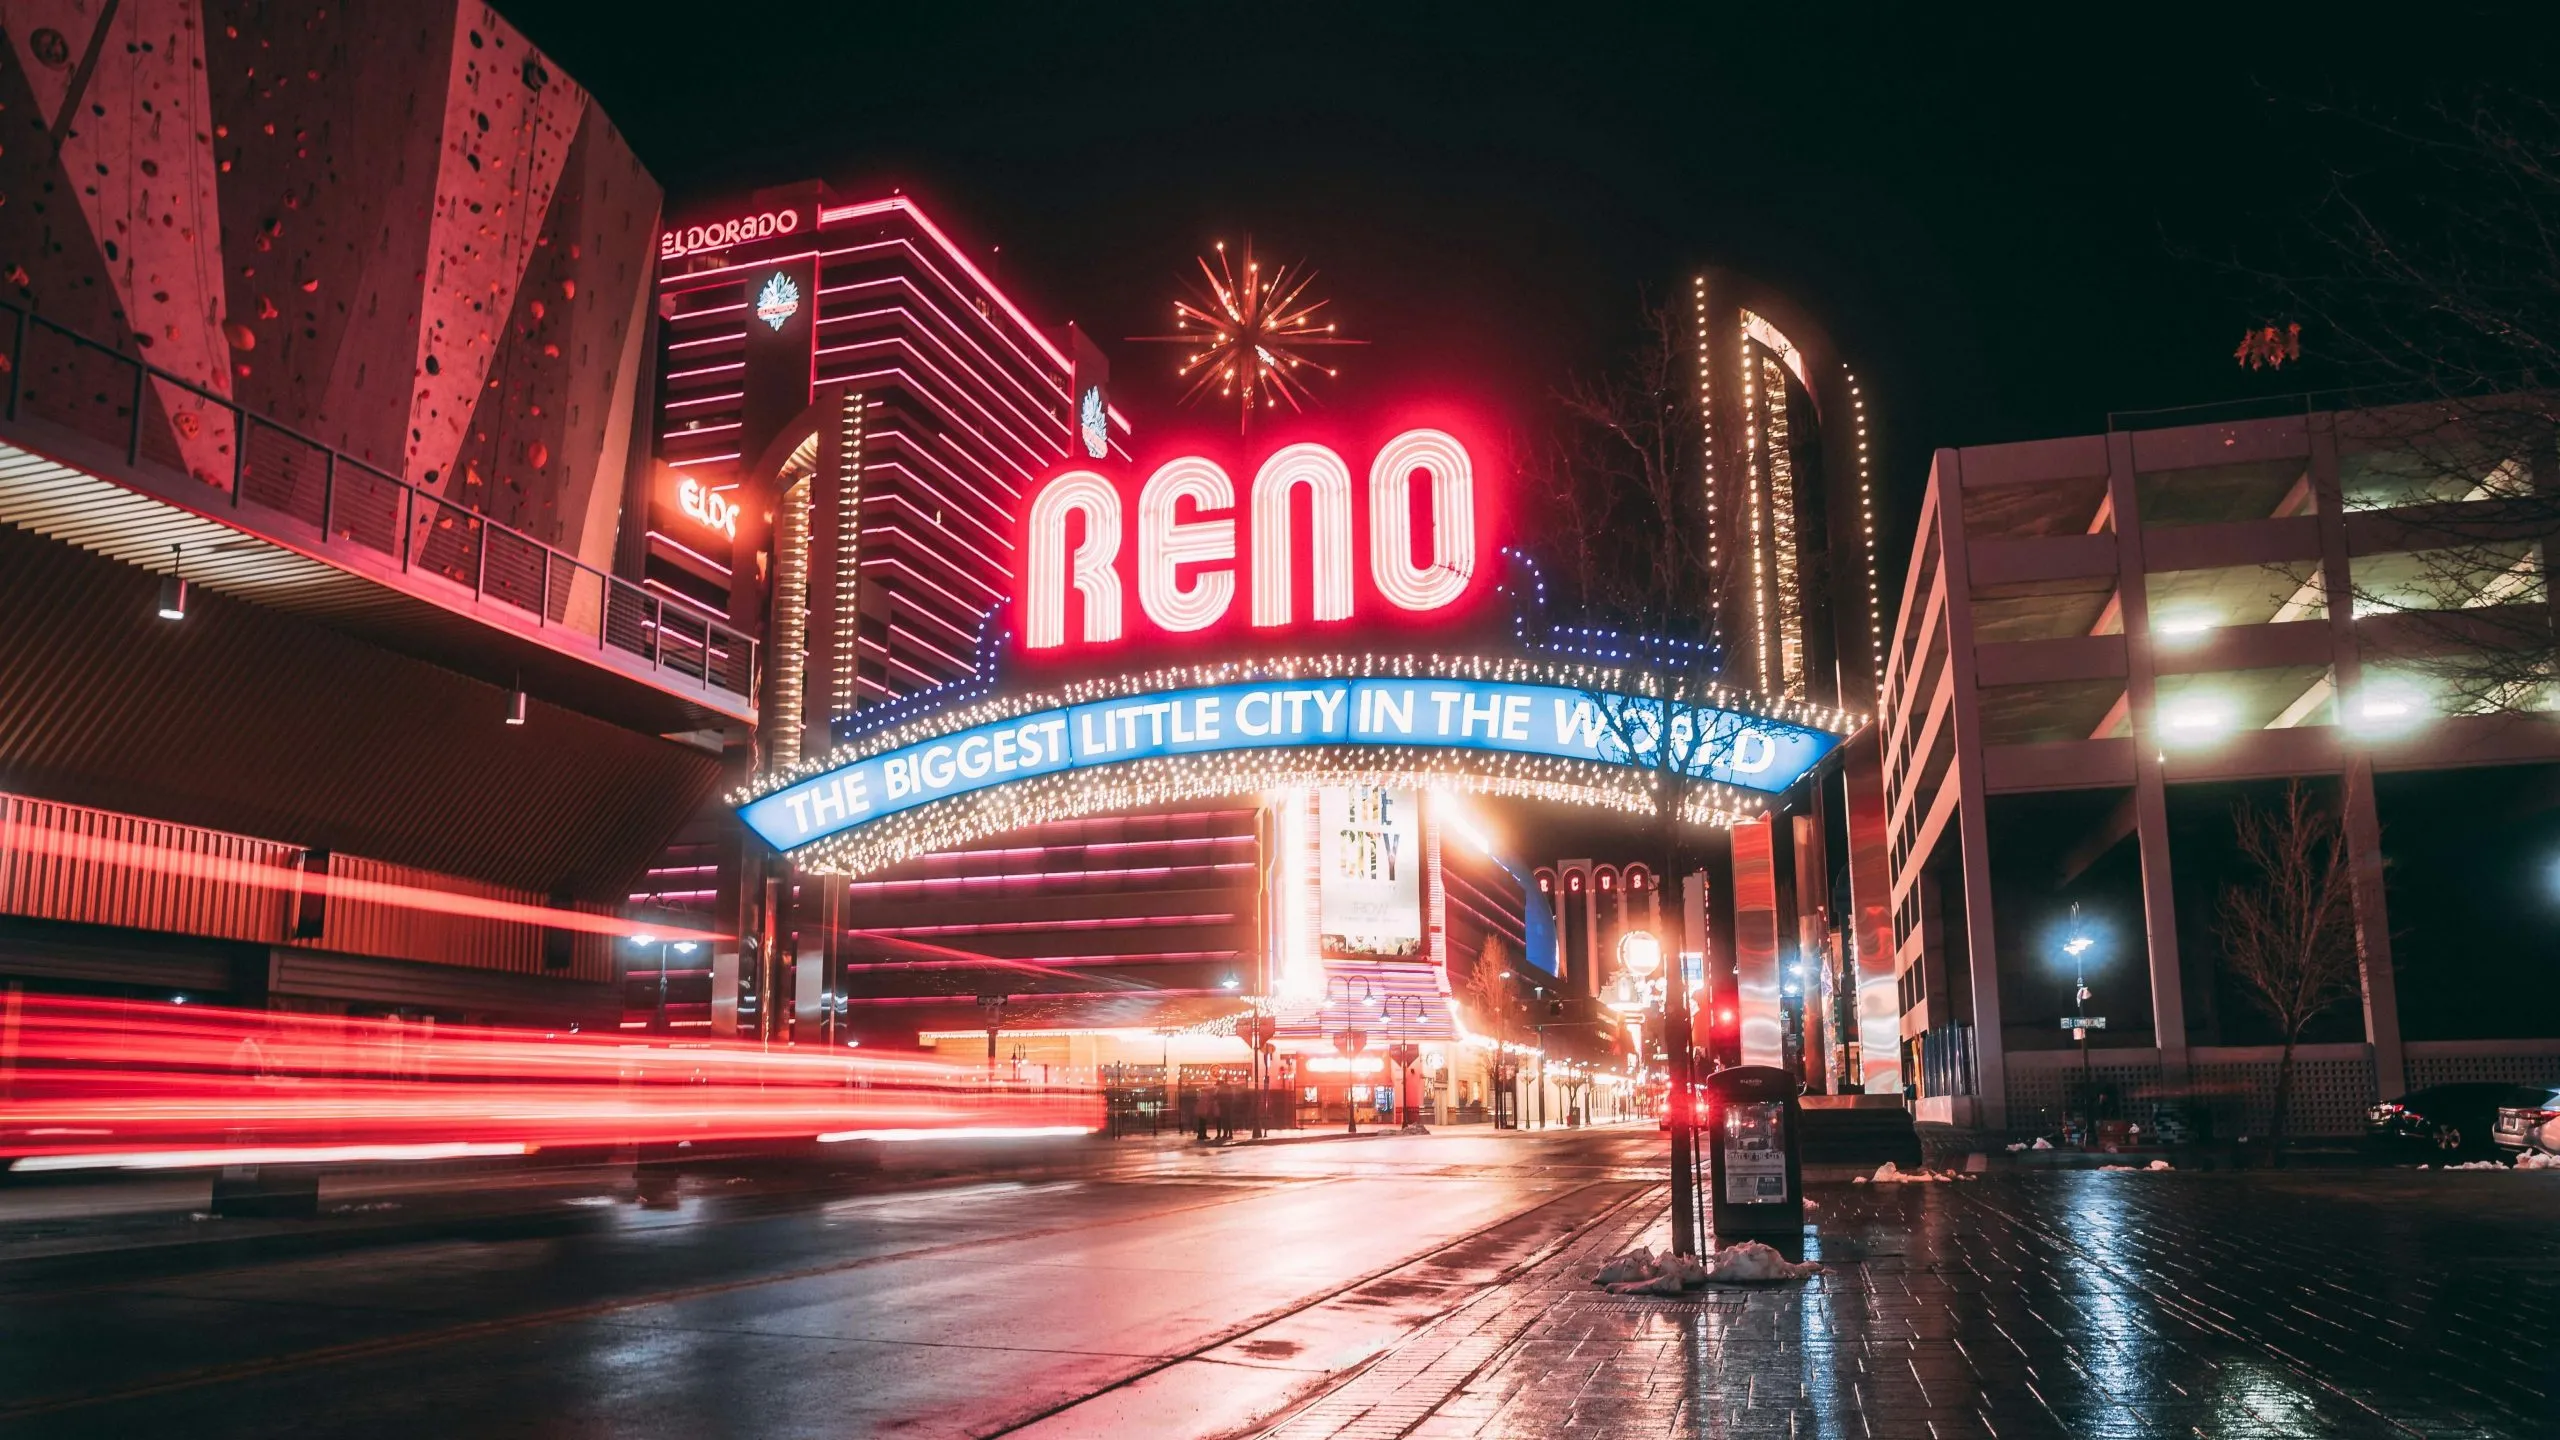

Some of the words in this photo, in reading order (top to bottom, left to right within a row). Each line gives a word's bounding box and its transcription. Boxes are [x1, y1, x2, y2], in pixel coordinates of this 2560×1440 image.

[1026, 428, 1476, 649] RENO
[785, 771, 870, 834] THE
[883, 718, 1066, 800] BIGGEST
[1081, 696, 1220, 756] LITTLE
[1235, 689, 1346, 737] CITY
[1358, 689, 1415, 734] IN
[1430, 691, 1532, 741] THE
[1340, 829, 1400, 881] CITY
